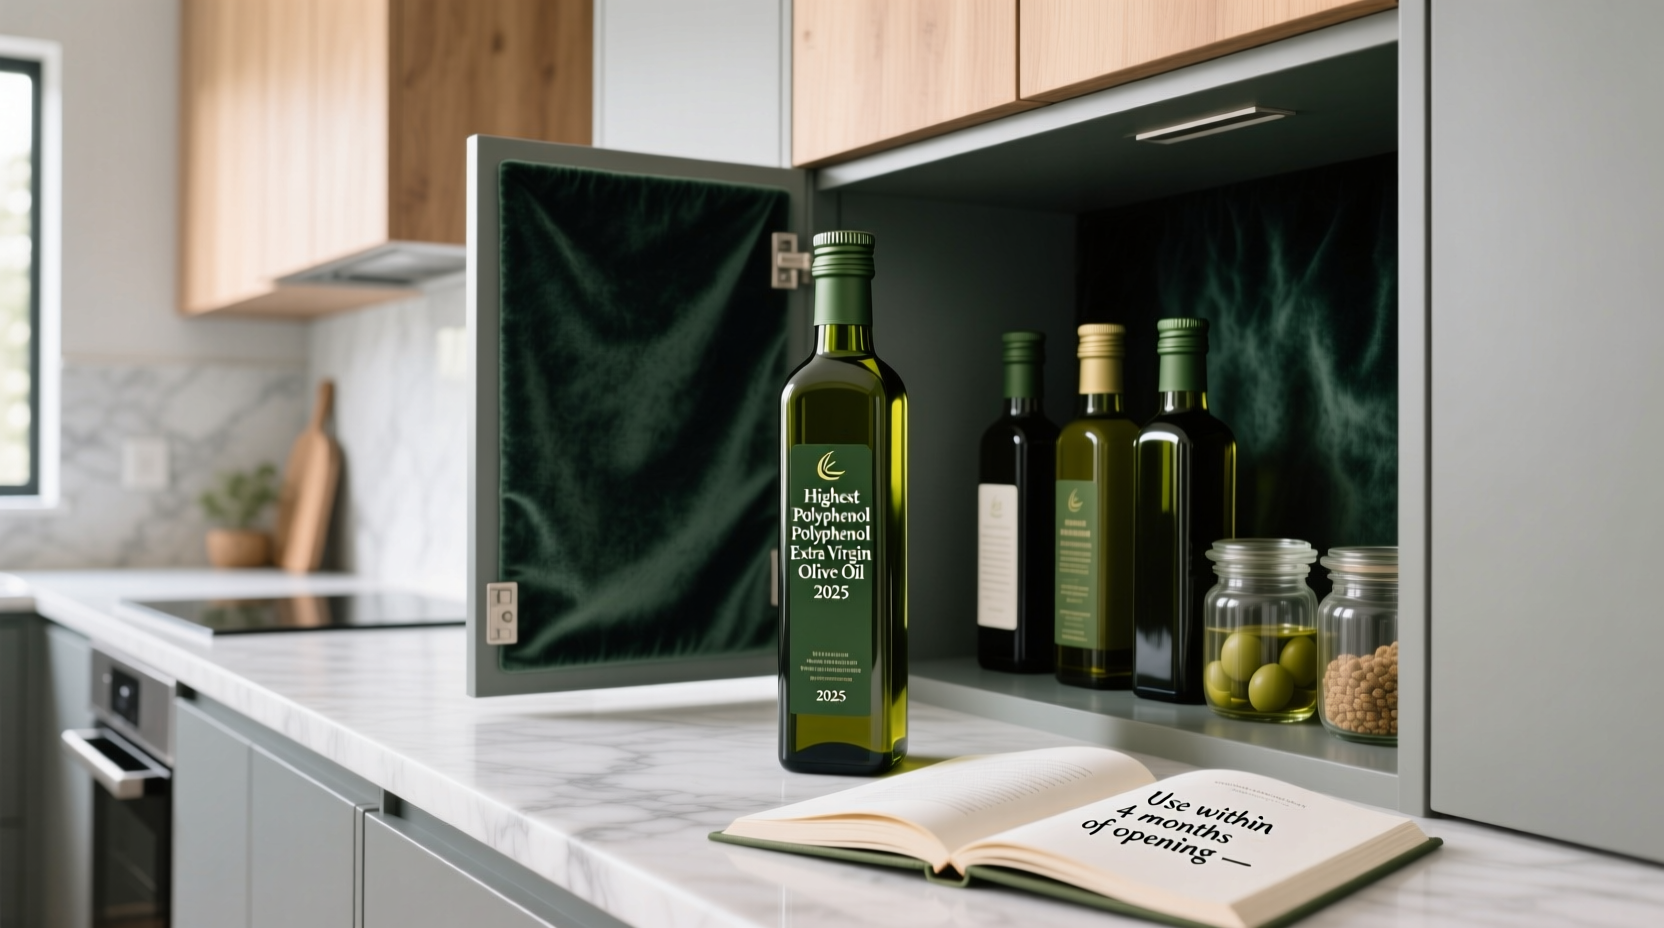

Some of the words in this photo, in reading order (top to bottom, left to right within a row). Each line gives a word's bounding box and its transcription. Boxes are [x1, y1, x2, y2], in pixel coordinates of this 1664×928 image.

[792, 507, 870, 526] Polyphenol
[792, 525, 870, 545] Polyphenol
[790, 545, 825, 560] Extra
[827, 545, 871, 564] Virgin
[798, 563, 838, 579] Olive
[841, 563, 864, 579] Oil
[813, 585, 849, 600] 2025
[816, 690, 846, 702] 2025
[1147, 791, 1190, 811] Use
[1196, 807, 1273, 835] within
[1116, 805, 1137, 818] 4
[1138, 813, 1233, 844] months
[1081, 819, 1117, 835] of
[1113, 827, 1217, 865] opening
